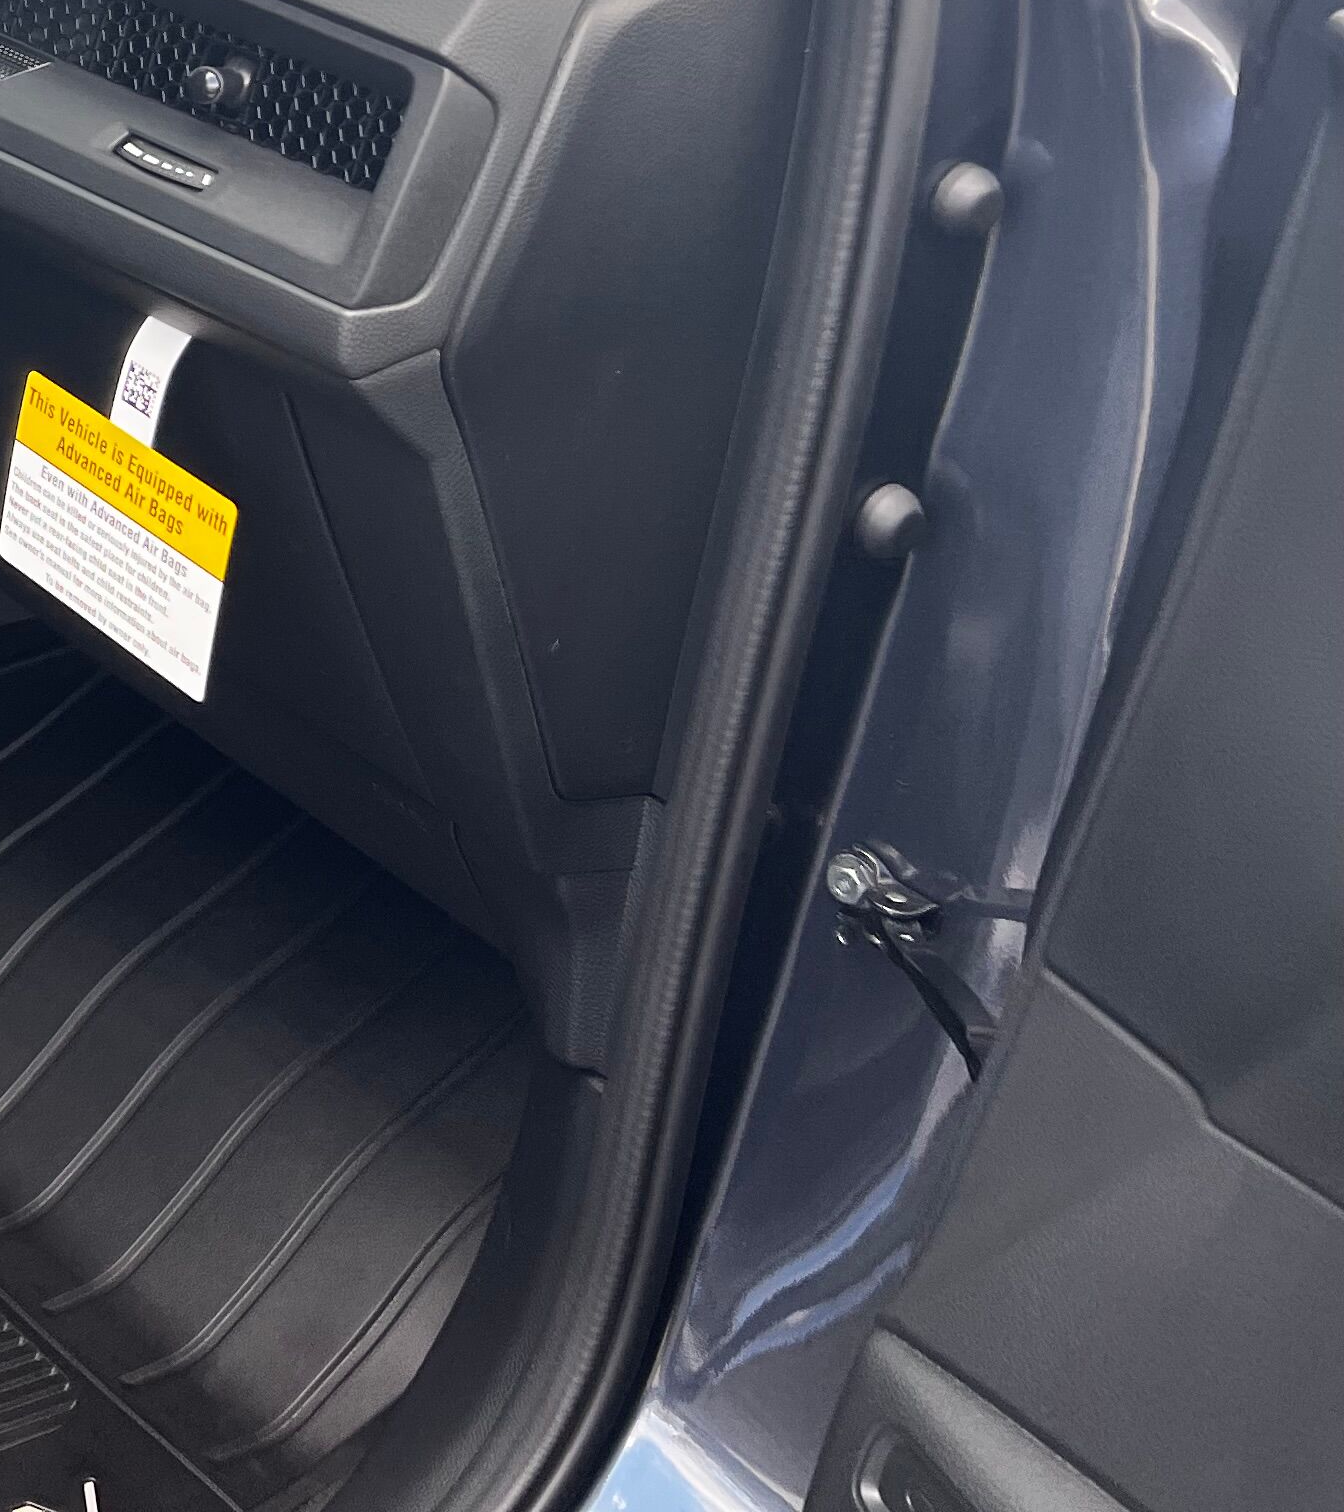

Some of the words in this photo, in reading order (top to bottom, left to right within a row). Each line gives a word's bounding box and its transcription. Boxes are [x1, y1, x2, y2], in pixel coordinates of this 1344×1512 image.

[28, 386, 55, 418] This
[58, 407, 107, 453] Vehicle
[111, 442, 124, 464] is
[127, 453, 193, 514] Equipped
[196, 499, 227, 535] with
[56, 434, 121, 491] Advanced
[124, 480, 145, 508] Air
[148, 497, 184, 538] Bags
[6, 510, 30, 534] Always
[32, 530, 43, 543] use
[45, 539, 60, 555] seat
[62, 550, 79, 568] belts
[81, 564, 94, 579] and
[97, 575, 114, 594] child
[8, 495, 28, 516] Never
[30, 511, 41, 525] put
[88, 552, 106, 571] child
[108, 567, 124, 584] seat
[134, 585, 146, 600] the
[11, 481, 23, 495] The
[25, 491, 41, 508] back
[42, 503, 57, 520] seat
[67, 520, 78, 534] the
[80, 530, 102, 551] safest
[103, 547, 123, 568] place
[125, 562, 136, 576] for
[41, 464, 64, 490] Even
[67, 484, 88, 507] with
[90, 499, 140, 543] Advanced
[142, 535, 158, 556] Air
[160, 548, 187, 579] Bags
[42, 487, 55, 501] can
[66, 503, 86, 523] killed
[96, 525, 129, 556] seriously
[130, 549, 156, 574] injured
[169, 575, 180, 589] the
[182, 585, 193, 598] air
[4, 524, 17, 539] See
[45, 555, 71, 578] manual
[72, 574, 82, 586] for
[84, 583, 101, 601] more
[146, 627, 166, 648] about
[168, 644, 179, 657] air
[65, 589, 96, 616] removed
[108, 621, 130, 641] owner
